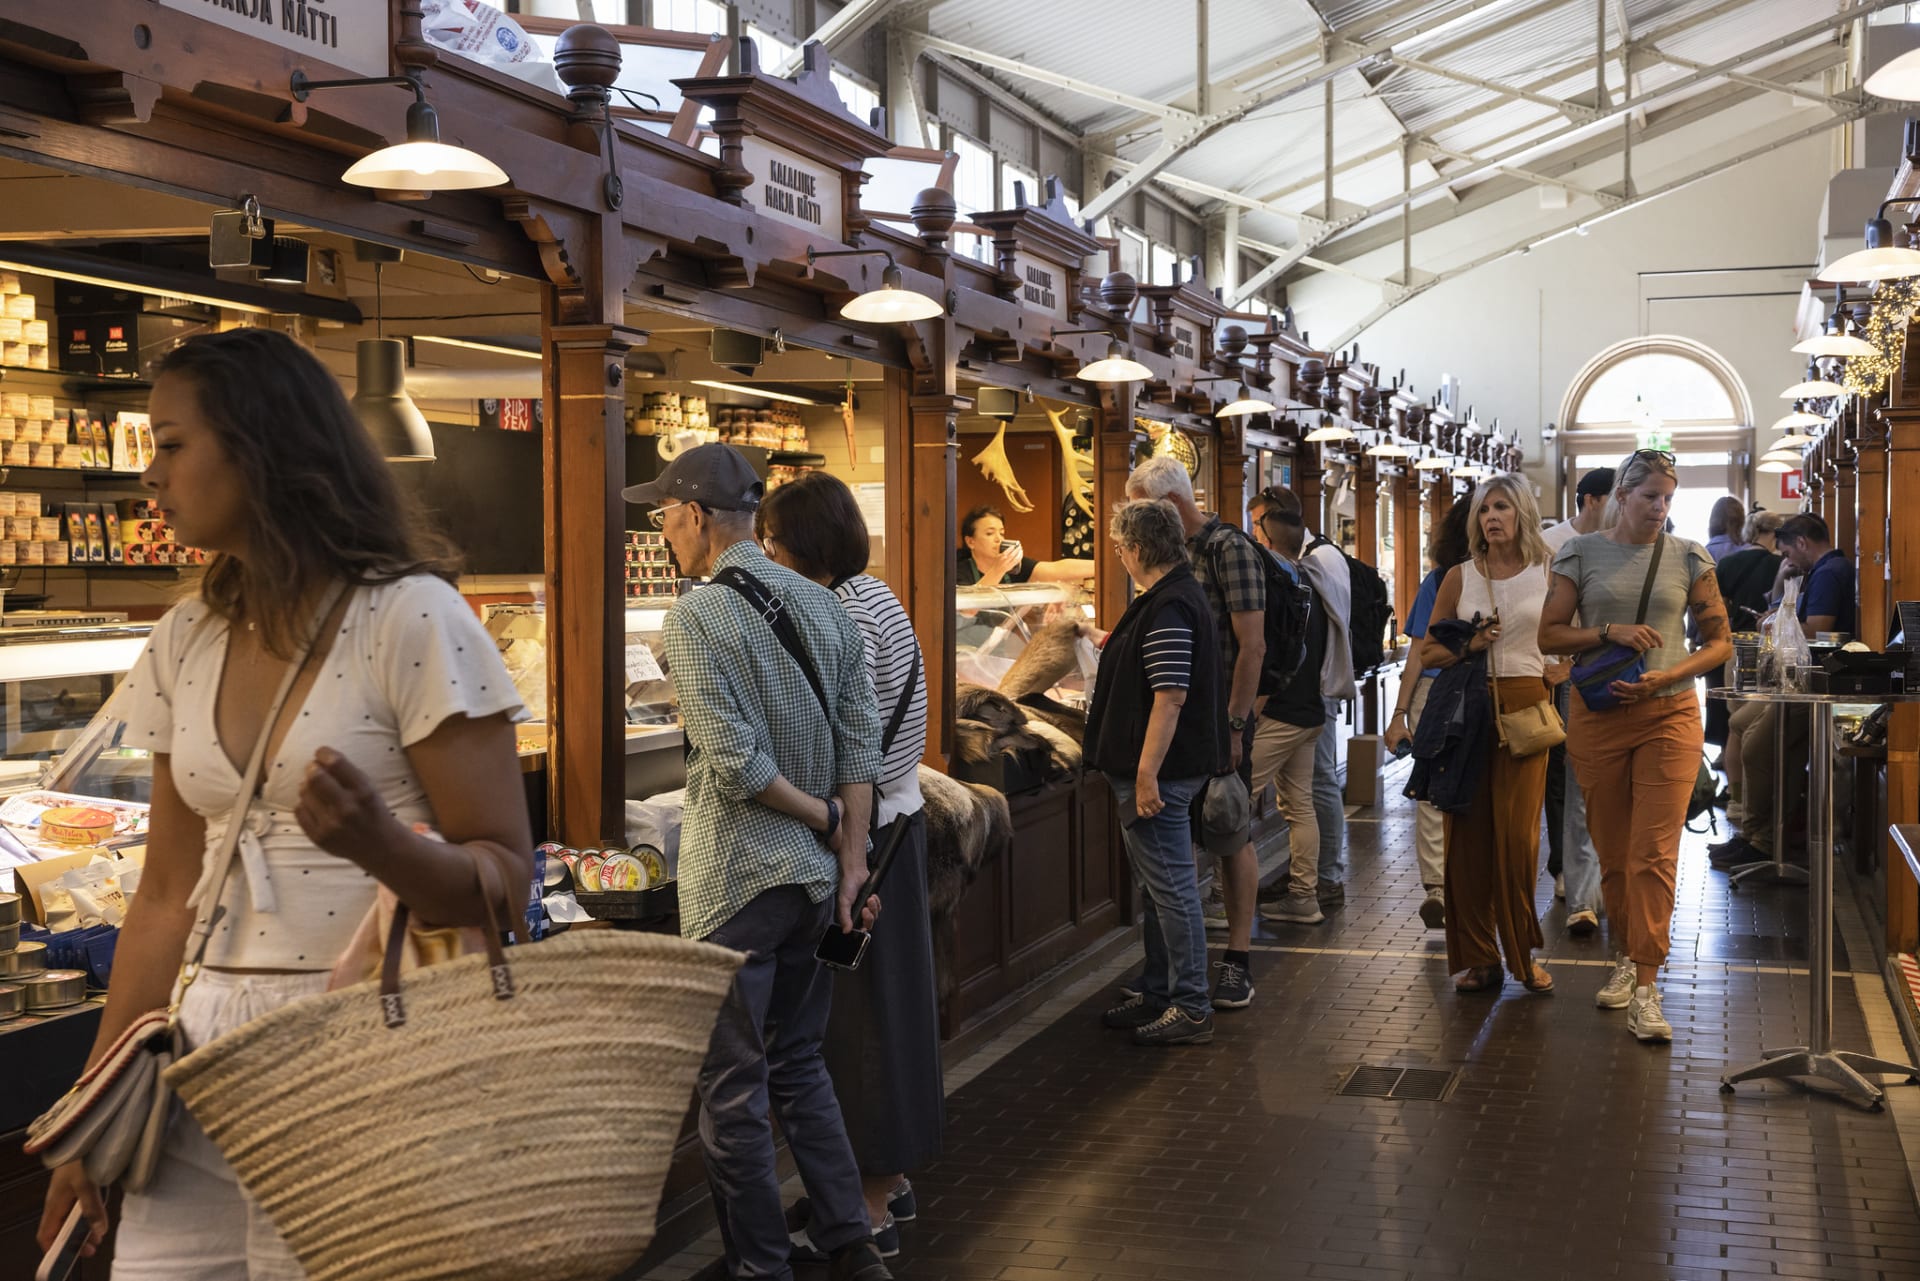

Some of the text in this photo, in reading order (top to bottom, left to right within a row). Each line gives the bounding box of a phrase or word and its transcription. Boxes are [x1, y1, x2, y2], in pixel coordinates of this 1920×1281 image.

[282, 0, 338, 48] NÄTTI
[770, 160, 816, 198] KALALIIKE
[797, 195, 821, 226] NÄTTI
[504, 415, 528, 431] SEN
